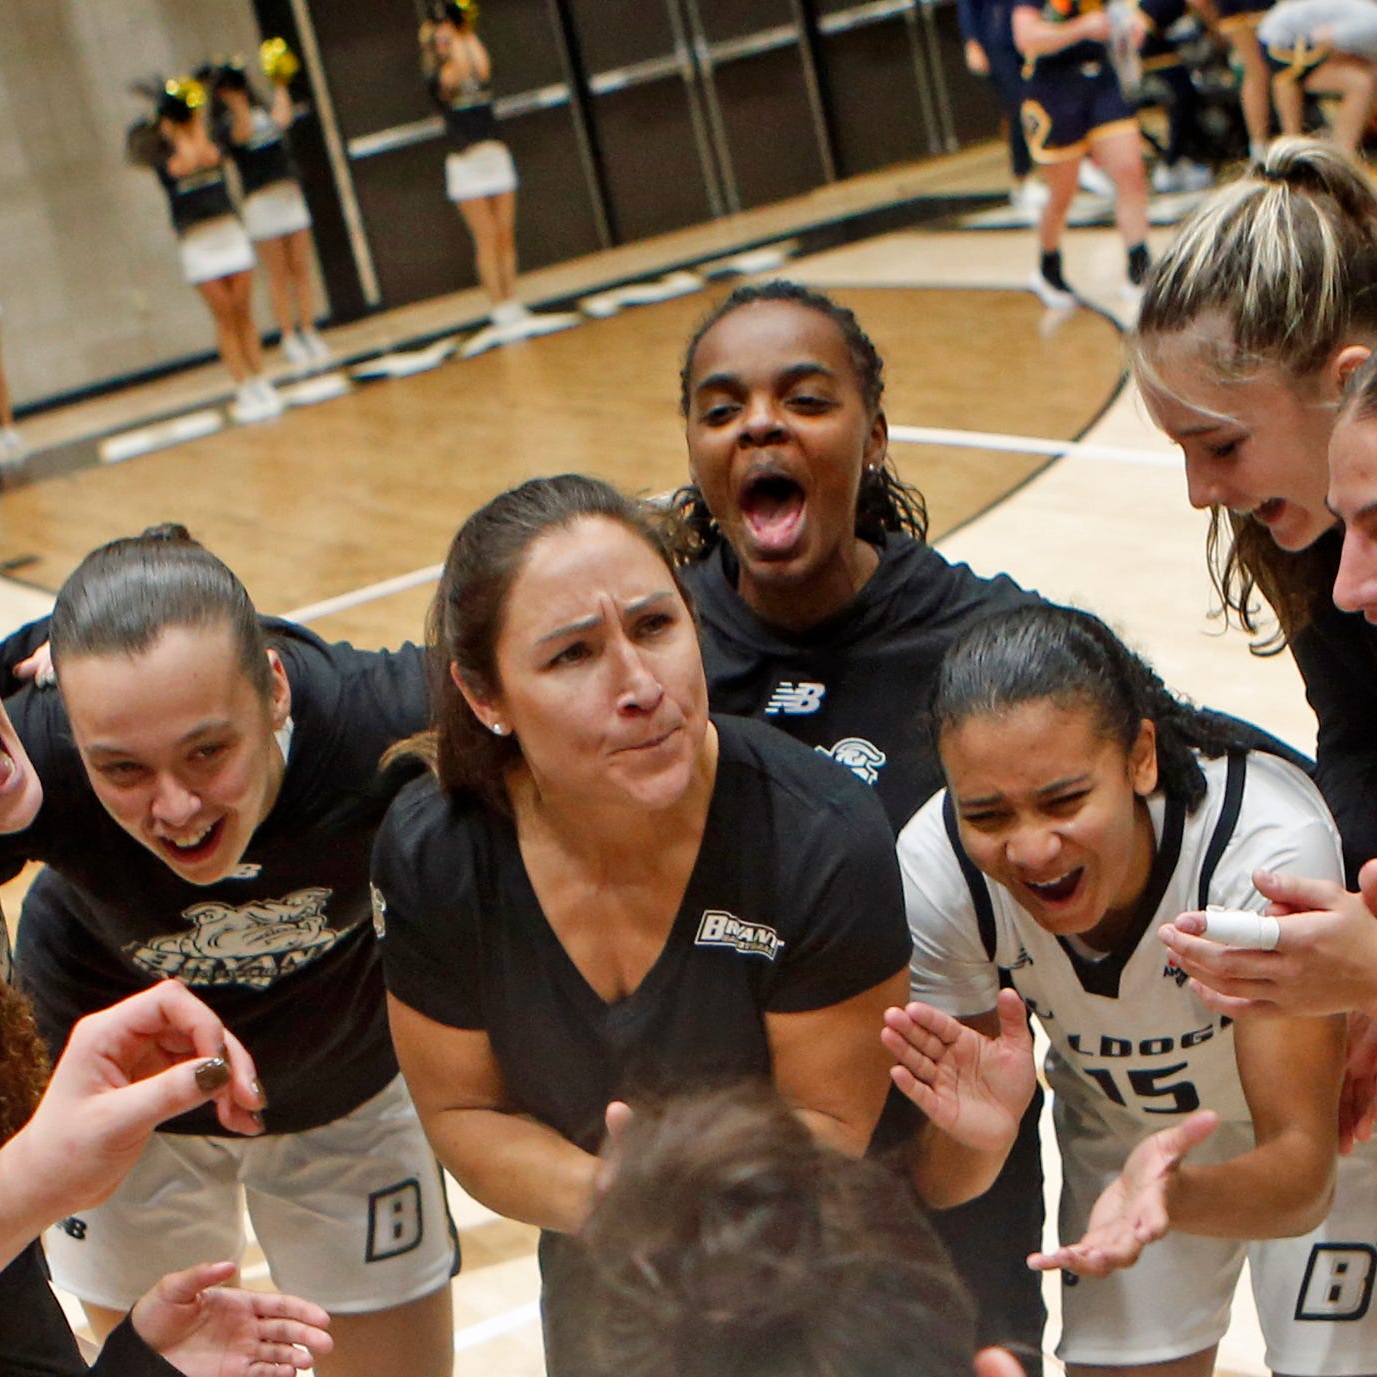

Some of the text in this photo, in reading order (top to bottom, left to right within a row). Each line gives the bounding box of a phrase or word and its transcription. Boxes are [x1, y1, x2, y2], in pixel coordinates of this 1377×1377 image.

[700, 914, 785, 949] BRYANT
[1083, 1062, 1200, 1114] 15
[365, 1177, 423, 1263] B
[1294, 1243, 1377, 1322] B
